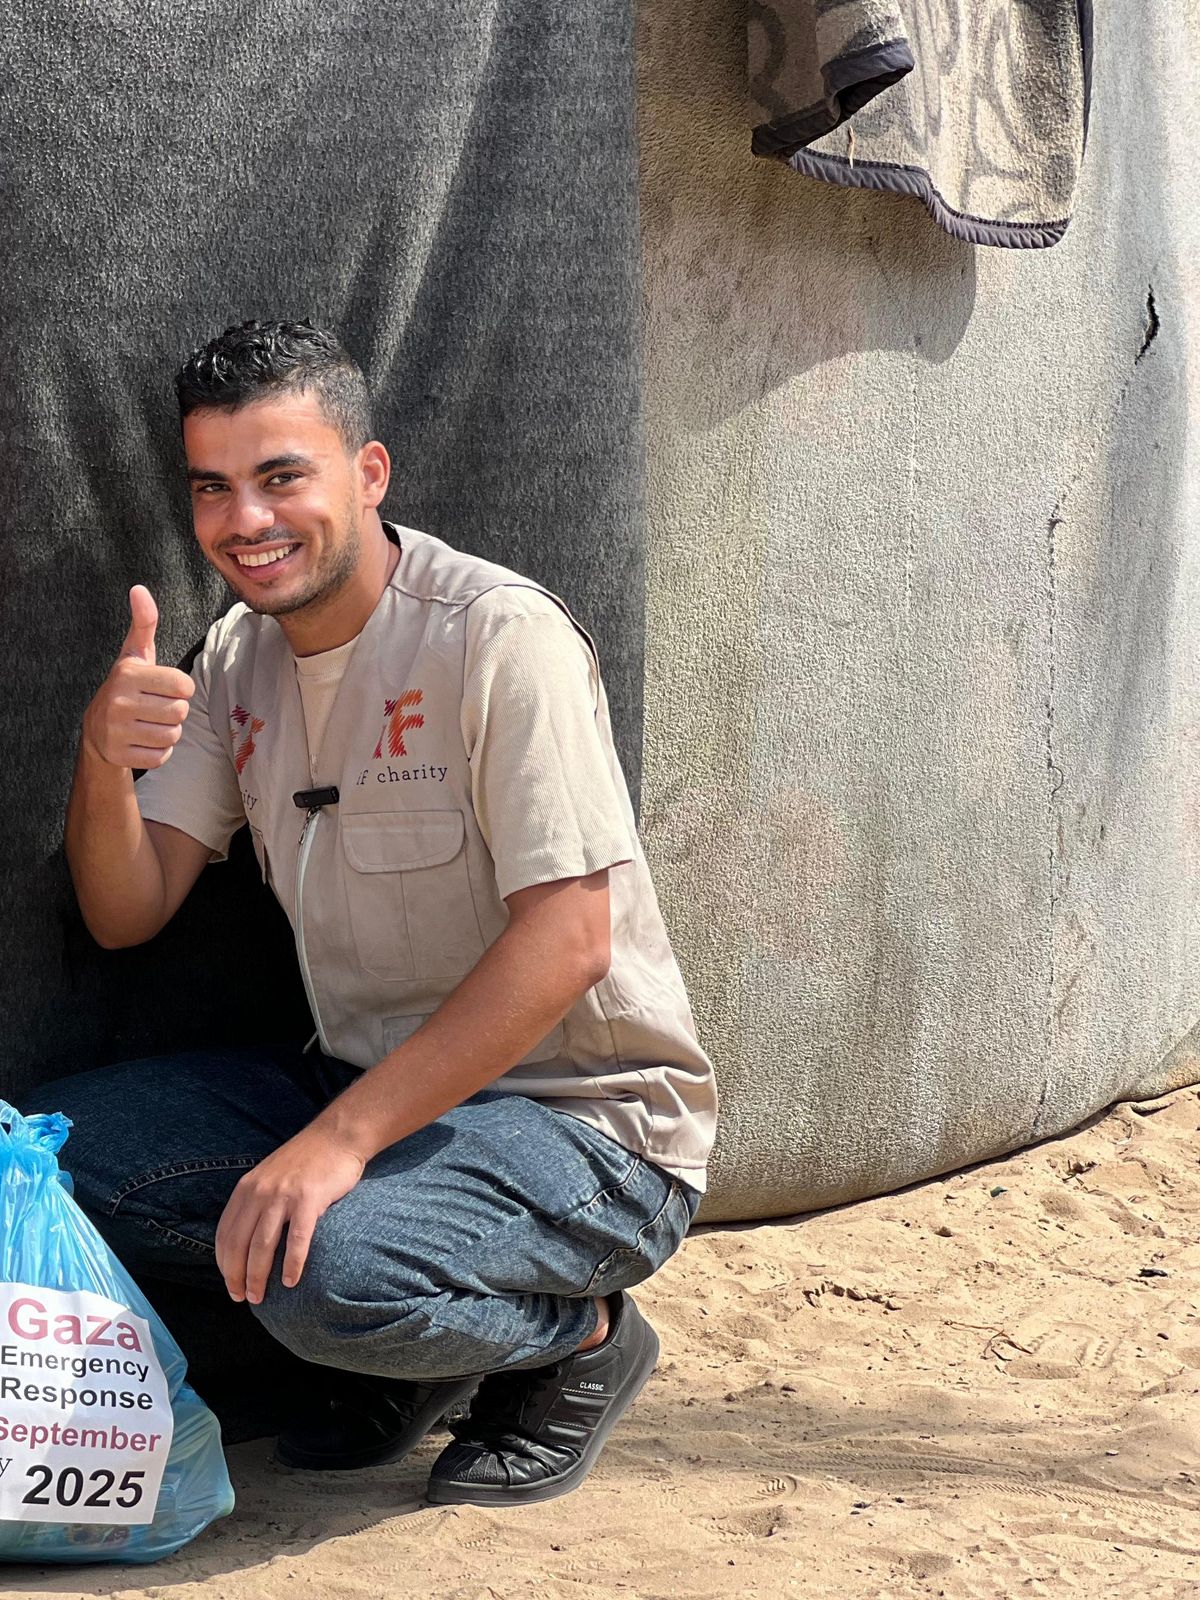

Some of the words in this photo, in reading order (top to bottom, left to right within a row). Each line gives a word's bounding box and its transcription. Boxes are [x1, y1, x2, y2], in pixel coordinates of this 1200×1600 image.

[376, 763, 448, 783] charity
[7, 1298, 143, 1353] Gaza
[0, 1345, 150, 1382] Emergency
[0, 1377, 154, 1411] Response
[579, 1381, 604, 1391] CLASSIC
[22, 1464, 145, 1508] 2025
